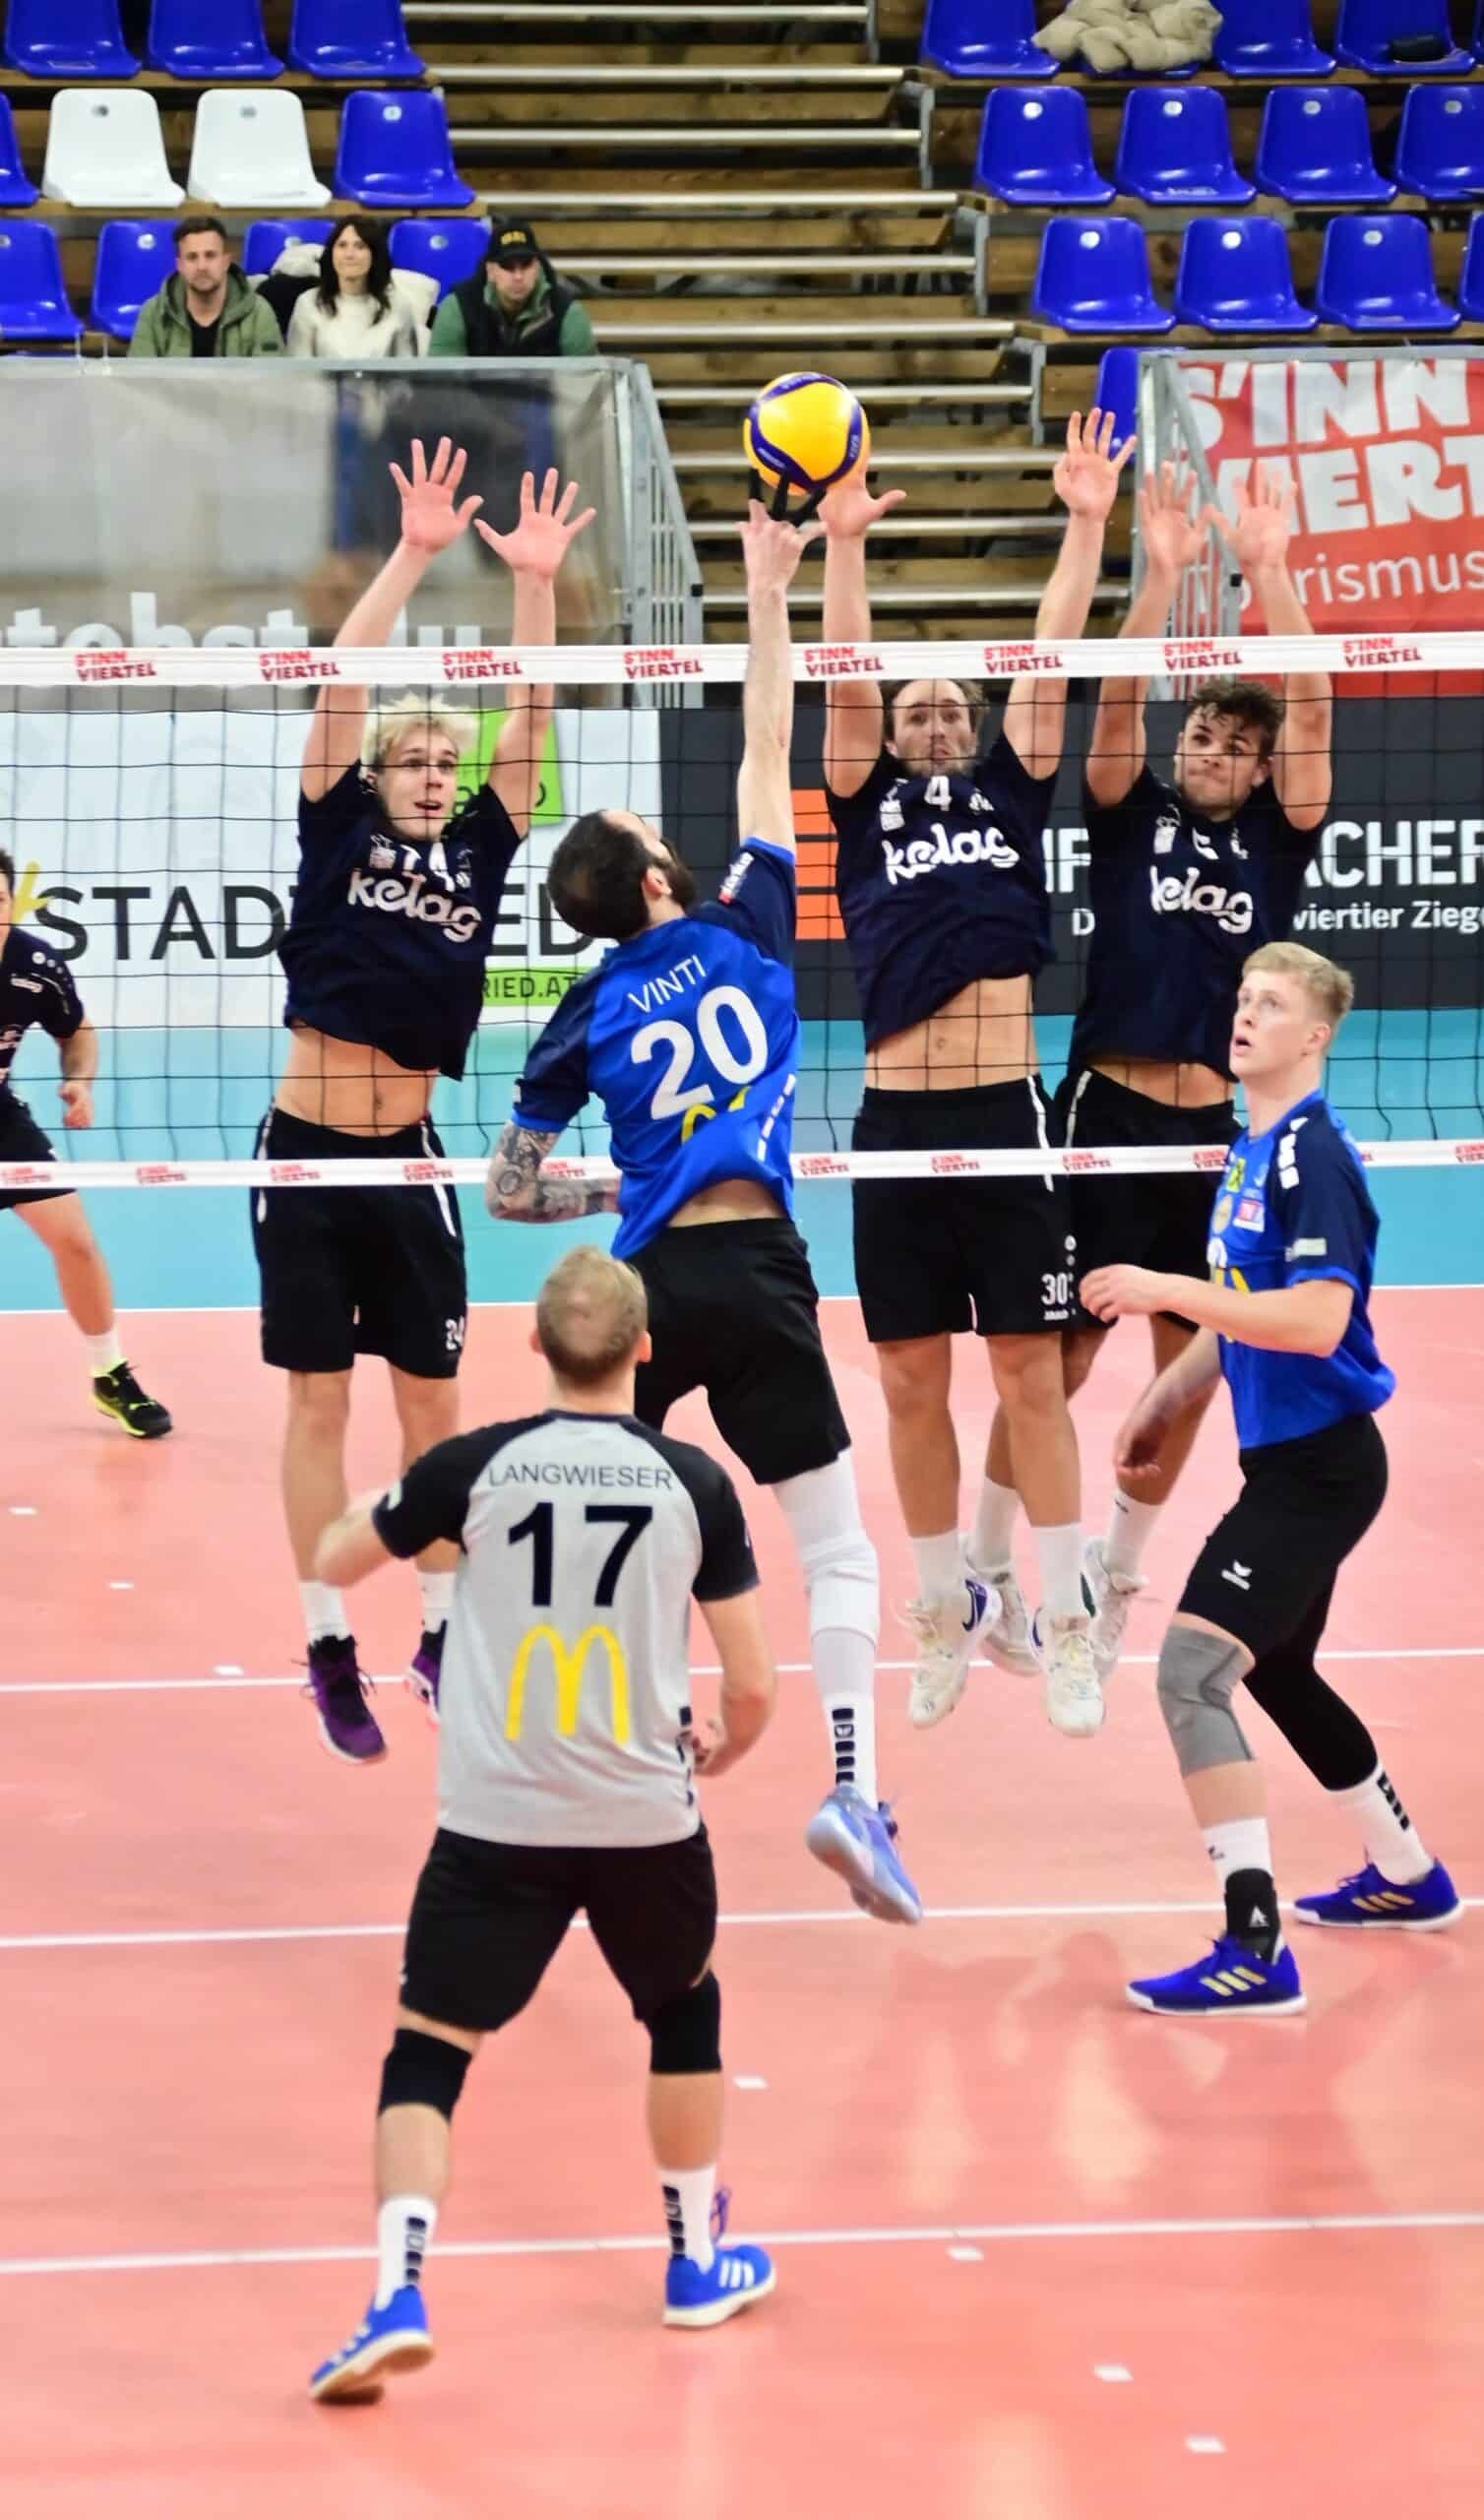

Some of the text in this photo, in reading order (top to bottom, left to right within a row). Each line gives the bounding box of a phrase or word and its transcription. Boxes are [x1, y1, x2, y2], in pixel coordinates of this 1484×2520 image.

[626, 659, 704, 679] VIERTEL
[806, 657, 884, 676] VIERTEL
[986, 655, 1063, 673] VIERTEL
[1165, 652, 1243, 670] VIERTEL
[1344, 648, 1423, 667] VIERTEL
[77, 662, 156, 681] VIERTEL
[262, 662, 340, 681] VIERTEL
[444, 662, 523, 680] VIERTEL
[347, 867, 482, 943] kelag
[34, 886, 295, 961] STAD
[1410, 900, 1484, 934] Zieg
[628, 955, 707, 1013] VINTI
[631, 985, 769, 1120] 20
[1041, 1273, 1068, 1305] 30
[489, 1464, 673, 1491] LANGWIESER
[508, 1502, 653, 1607] 17
